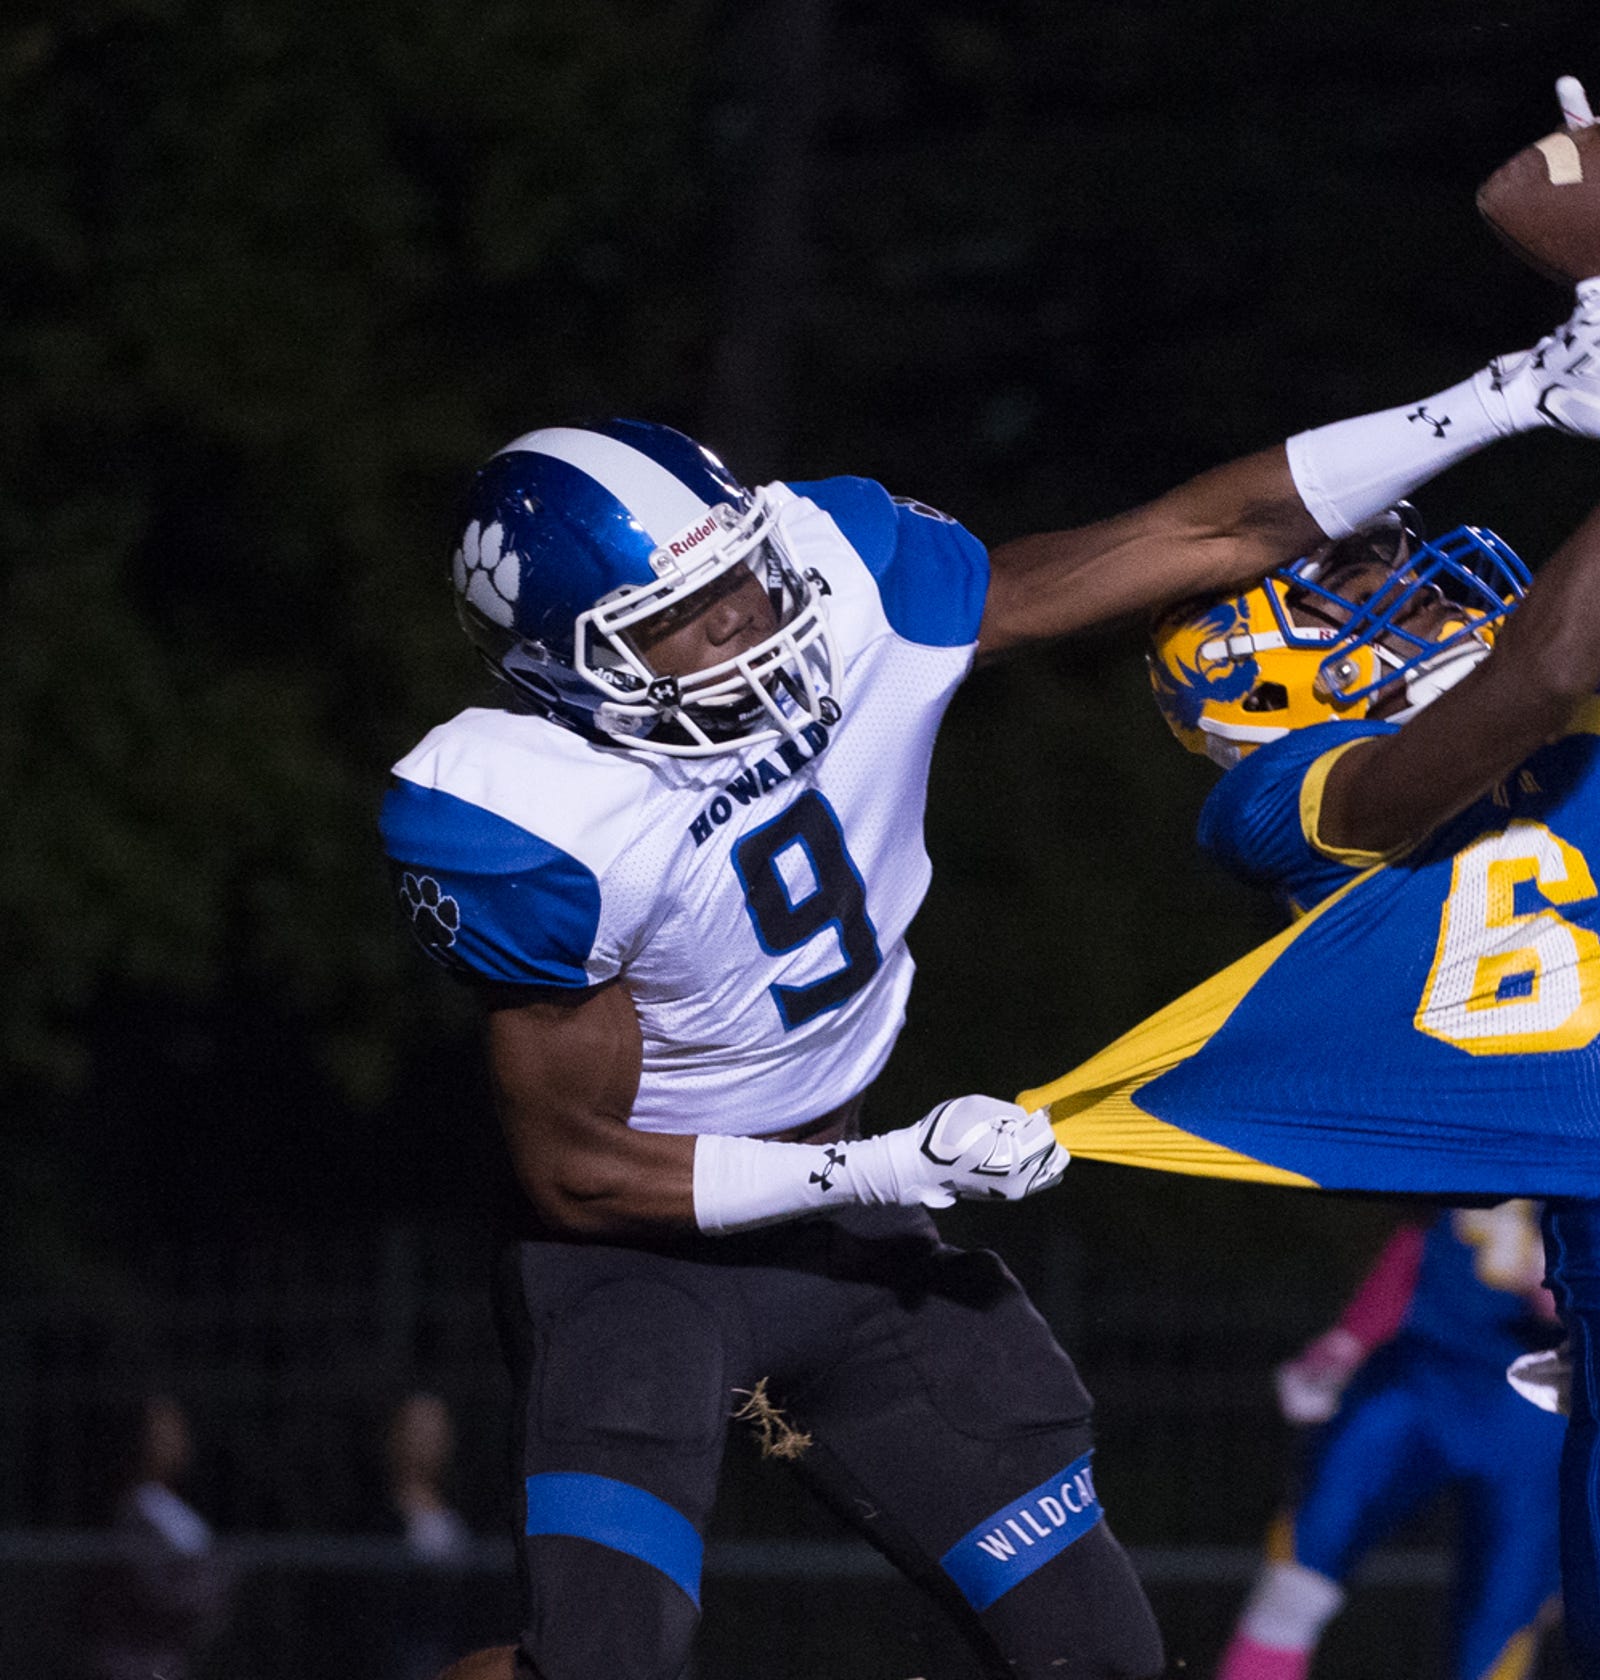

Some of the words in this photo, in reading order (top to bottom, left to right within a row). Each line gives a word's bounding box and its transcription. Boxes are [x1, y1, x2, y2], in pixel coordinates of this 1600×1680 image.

[669, 515, 718, 557] Riddell
[688, 720, 829, 848] HOWARD
[730, 788, 883, 1033] 9
